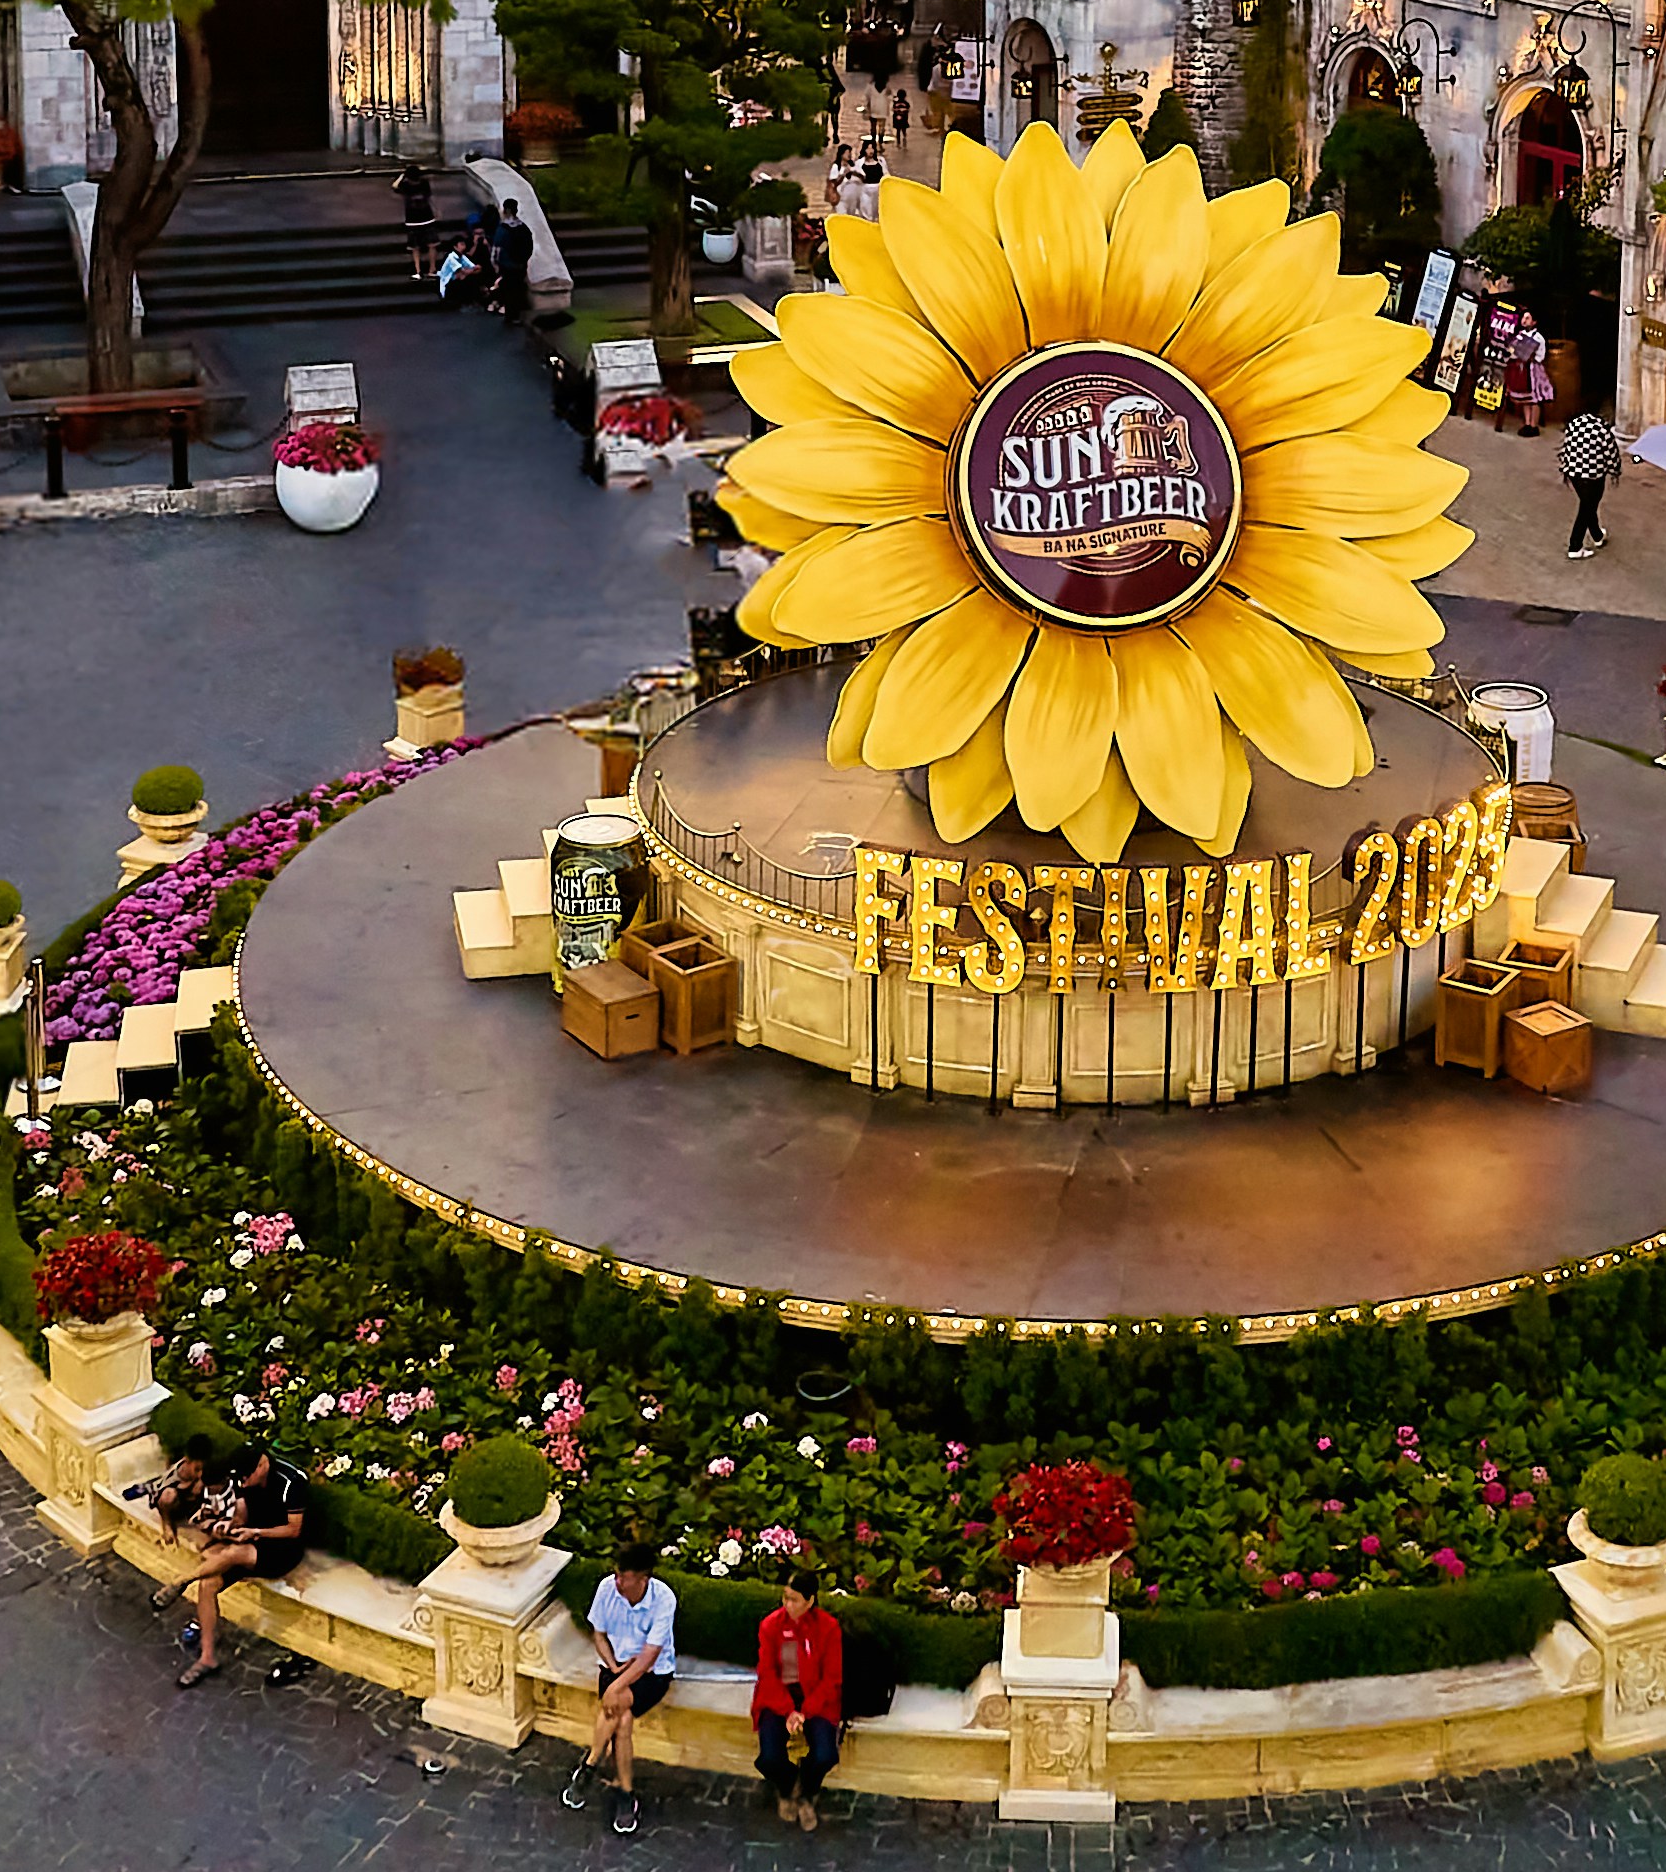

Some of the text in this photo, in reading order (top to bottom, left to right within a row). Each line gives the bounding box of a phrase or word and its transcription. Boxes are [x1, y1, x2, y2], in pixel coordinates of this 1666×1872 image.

[1003, 427, 1105, 488] SUN
[990, 476, 1209, 531] KRAFTBEER
[1043, 522, 1167, 553] BA NA SIGNATURE
[555, 874, 582, 898] SUN
[855, 847, 1330, 993] FESTIVAL
